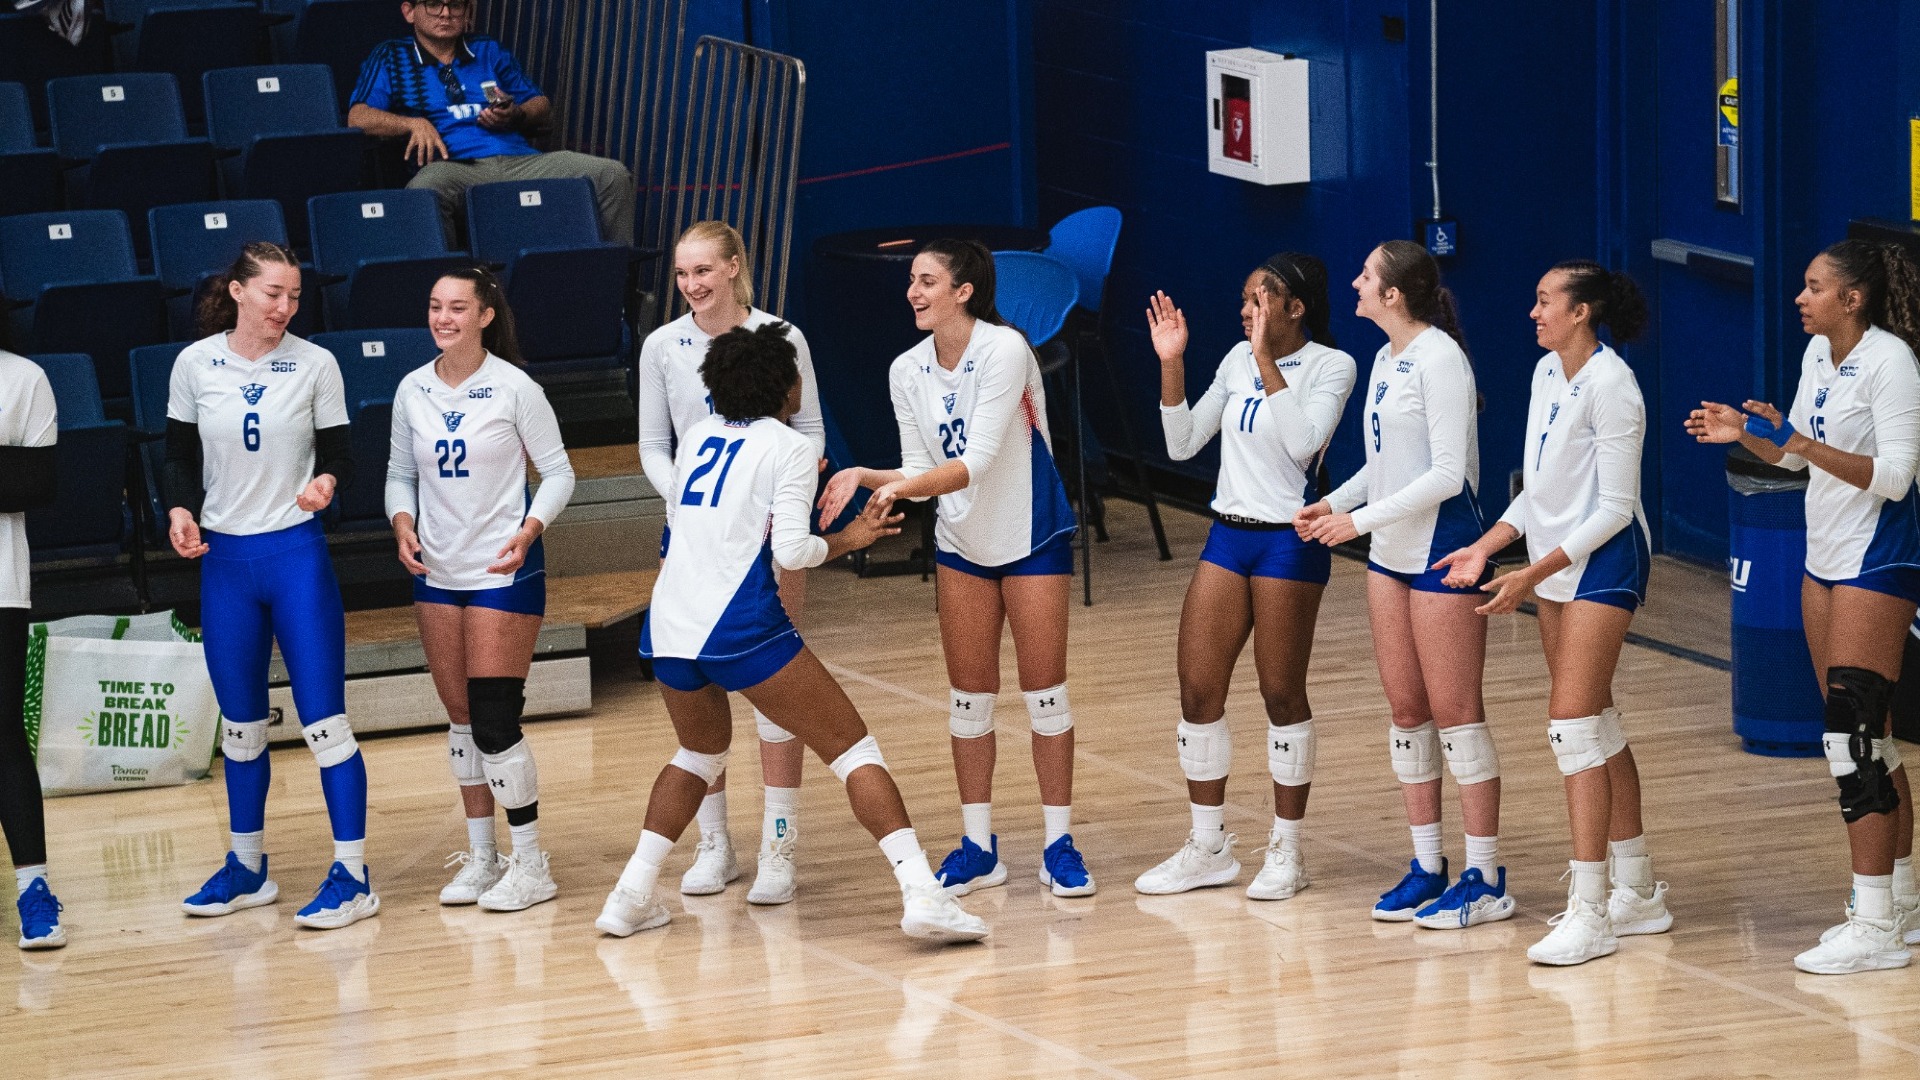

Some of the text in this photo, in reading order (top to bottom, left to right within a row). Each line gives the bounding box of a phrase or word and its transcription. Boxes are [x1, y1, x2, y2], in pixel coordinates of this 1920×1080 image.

[704, 393, 715, 416] 1
[1239, 397, 1263, 433] 11
[243, 412, 261, 452] 6
[939, 417, 967, 459] 23
[1371, 411, 1381, 453] 9
[1809, 415, 1826, 444] 15
[434, 439, 470, 478] 22
[1536, 432, 1548, 472] 1
[680, 435, 746, 508] 21
[1730, 556, 1752, 587] U
[98, 680, 175, 695] TIME TO
[104, 696, 167, 710] BREAK
[98, 711, 170, 748] BREAD
[111, 765, 149, 775] Panera
